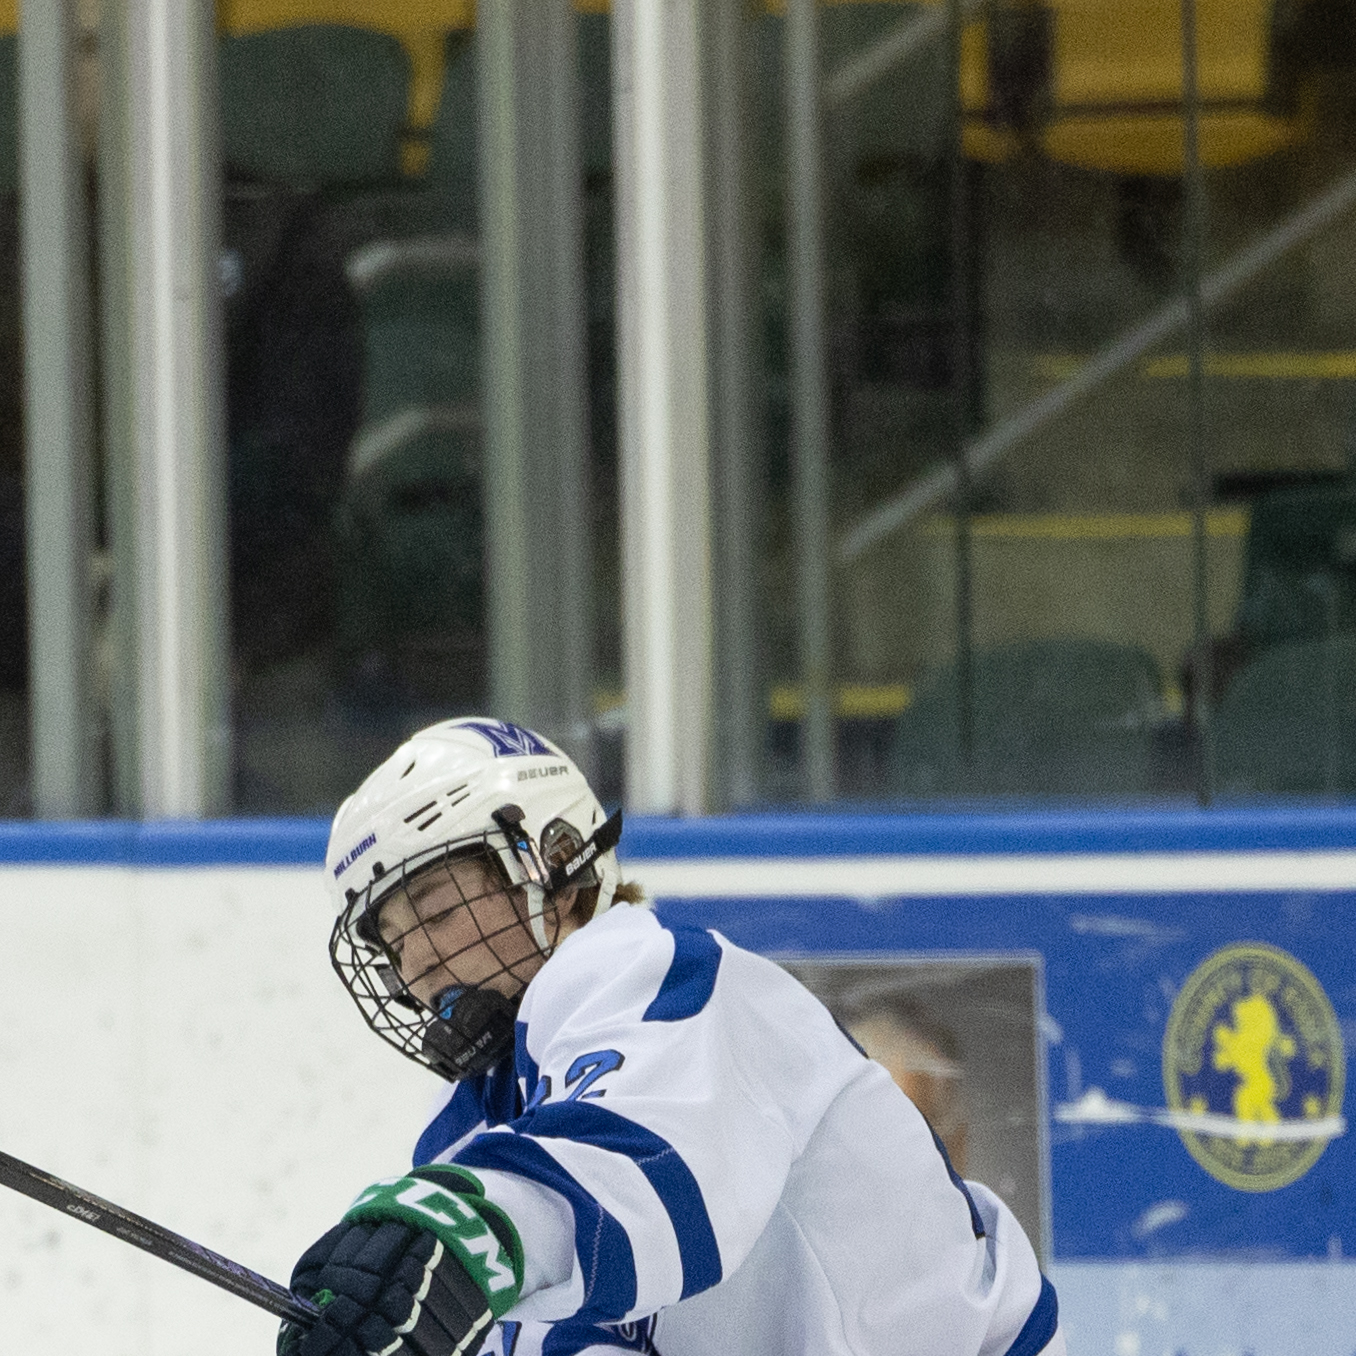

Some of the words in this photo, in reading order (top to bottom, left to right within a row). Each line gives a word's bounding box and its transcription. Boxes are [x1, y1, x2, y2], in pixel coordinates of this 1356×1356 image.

[451, 721, 560, 758] M
[517, 765, 570, 782] BAUER
[333, 833, 377, 880] MILLBURN
[565, 841, 598, 877] BAUER
